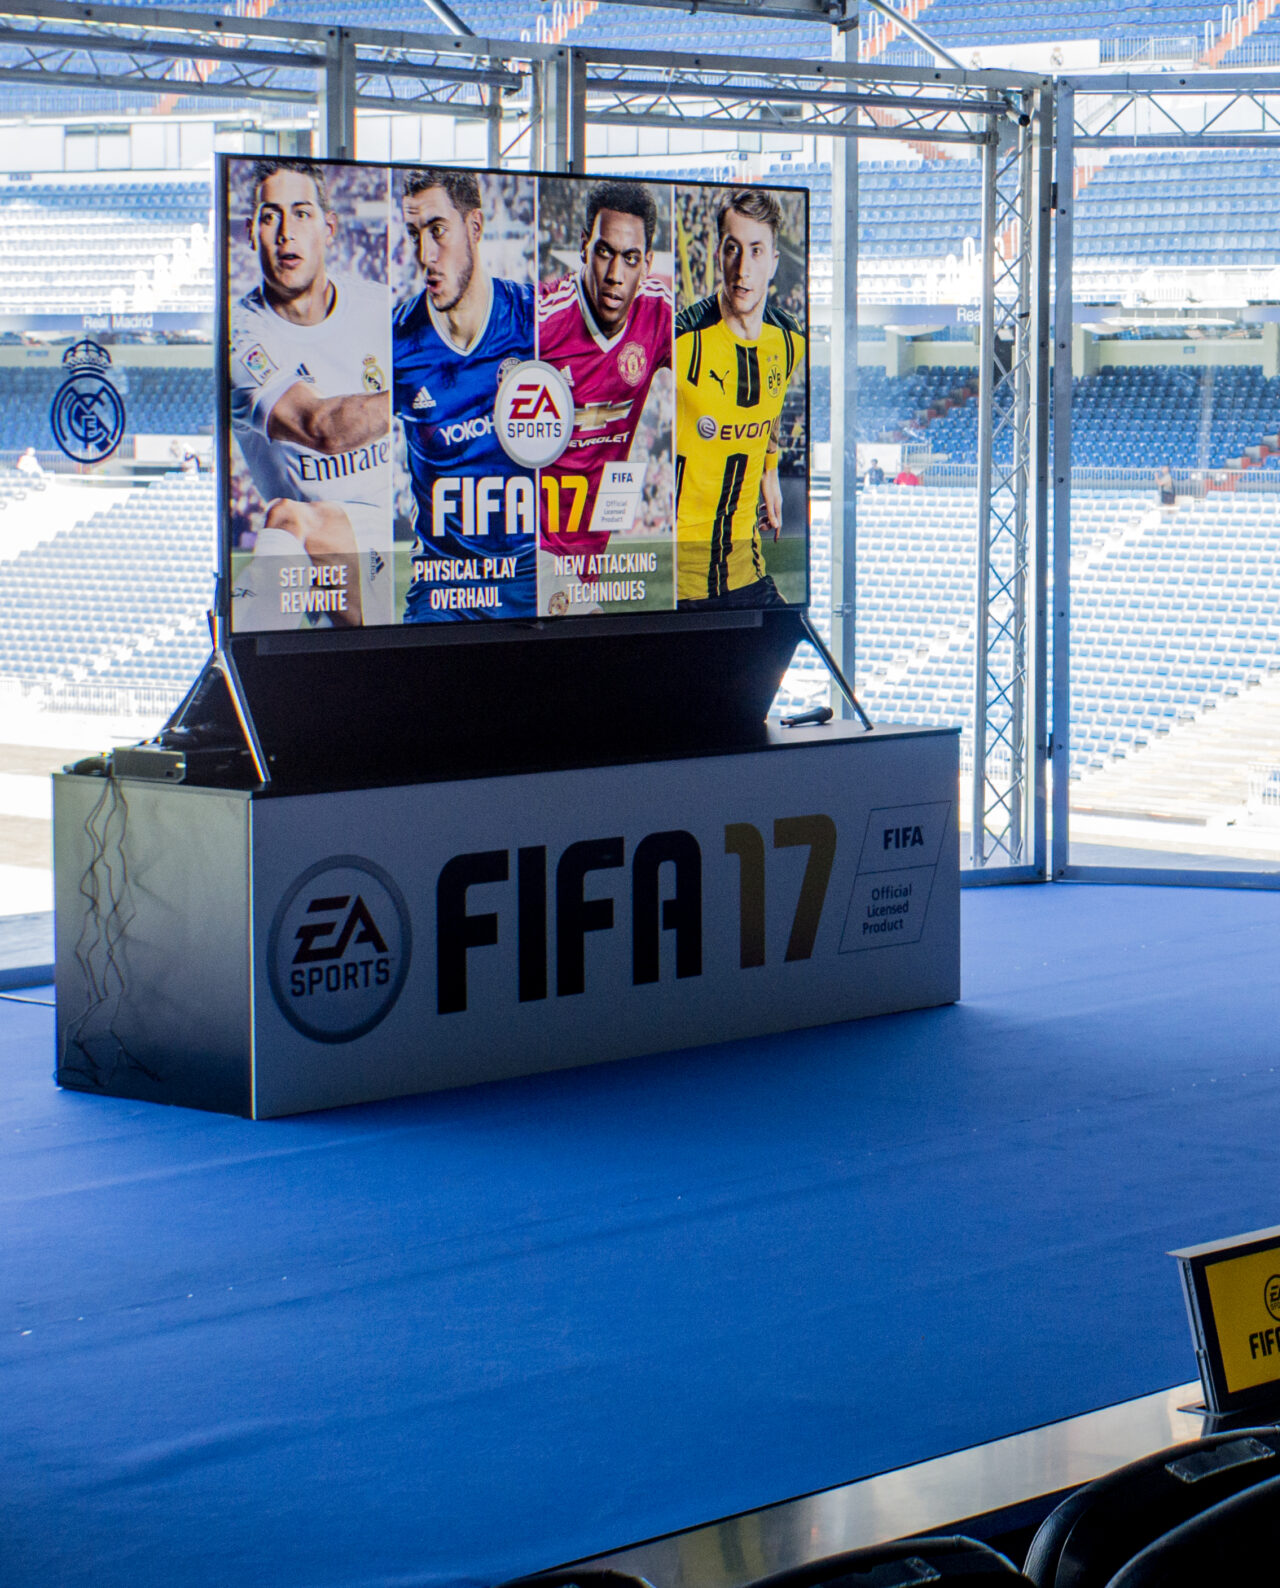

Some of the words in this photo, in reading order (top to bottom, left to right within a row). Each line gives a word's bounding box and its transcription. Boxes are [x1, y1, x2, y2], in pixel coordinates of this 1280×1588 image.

[83, 316, 109, 329] Real
[112, 315, 154, 329] Madrid
[956, 307, 982, 322] Rea
[509, 384, 561, 420] EA
[507, 422, 562, 438] SPORTS
[298, 441, 390, 481] Emirate
[612, 472, 633, 483] FIFA
[432, 475, 535, 537] FIFA
[541, 475, 588, 533] 17
[279, 567, 306, 588] SET
[309, 564, 348, 587] PIECE
[414, 559, 481, 582] PHYSICAL
[483, 557, 517, 579] PLAY
[554, 554, 585, 576] NEW
[588, 552, 657, 575] ATTACKING
[280, 589, 348, 613] REWRITE
[430, 586, 503, 610] OVERHAUL
[567, 580, 646, 603] TECHNIQUES
[883, 825, 925, 850] FIFA
[871, 884, 912, 901] Official
[436, 829, 703, 1016] FIFA
[724, 813, 837, 969] 17
[867, 901, 909, 918] Licensed
[292, 894, 389, 964] EA
[862, 918, 904, 935] Product
[291, 958, 390, 997] SPORTS
